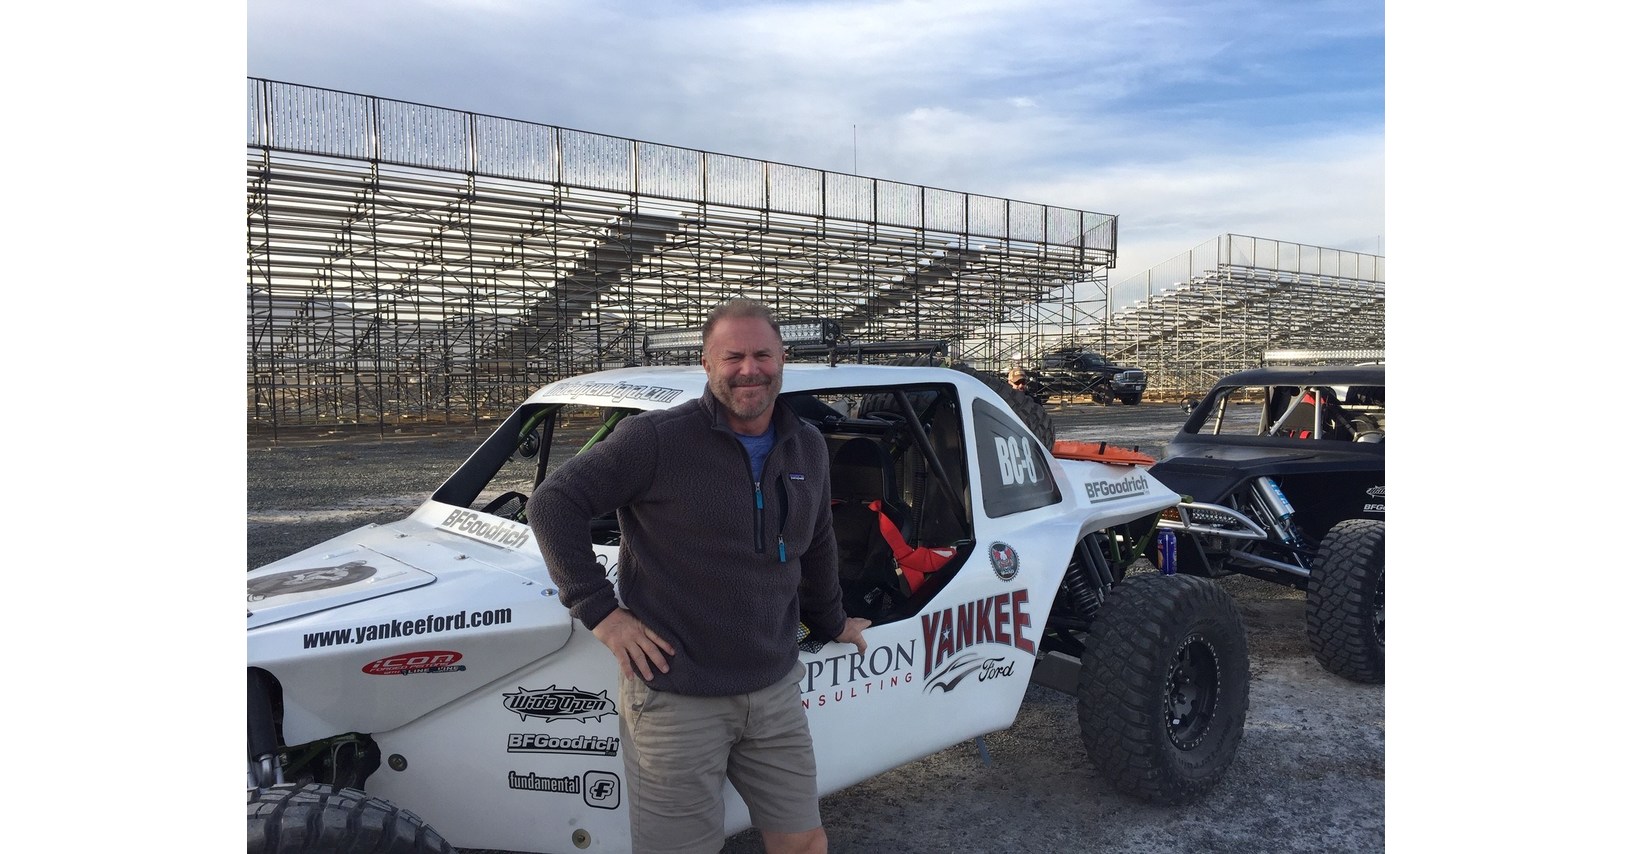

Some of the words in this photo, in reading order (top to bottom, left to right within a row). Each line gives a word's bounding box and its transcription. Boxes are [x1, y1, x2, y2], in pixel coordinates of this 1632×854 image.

[994, 436, 1037, 485] BC-8
[1085, 475, 1148, 498] BFGoodrich
[442, 509, 529, 548] BFGoodrich
[303, 608, 512, 649] www.yankeeford.com
[921, 588, 1036, 681] YANKEE
[800, 639, 917, 694] PTRON
[978, 657, 1015, 682] Ford
[509, 695, 557, 709] Wide
[560, 696, 607, 712] Open
[508, 734, 618, 751] BFGoodrich
[508, 771, 580, 794] fundamental
